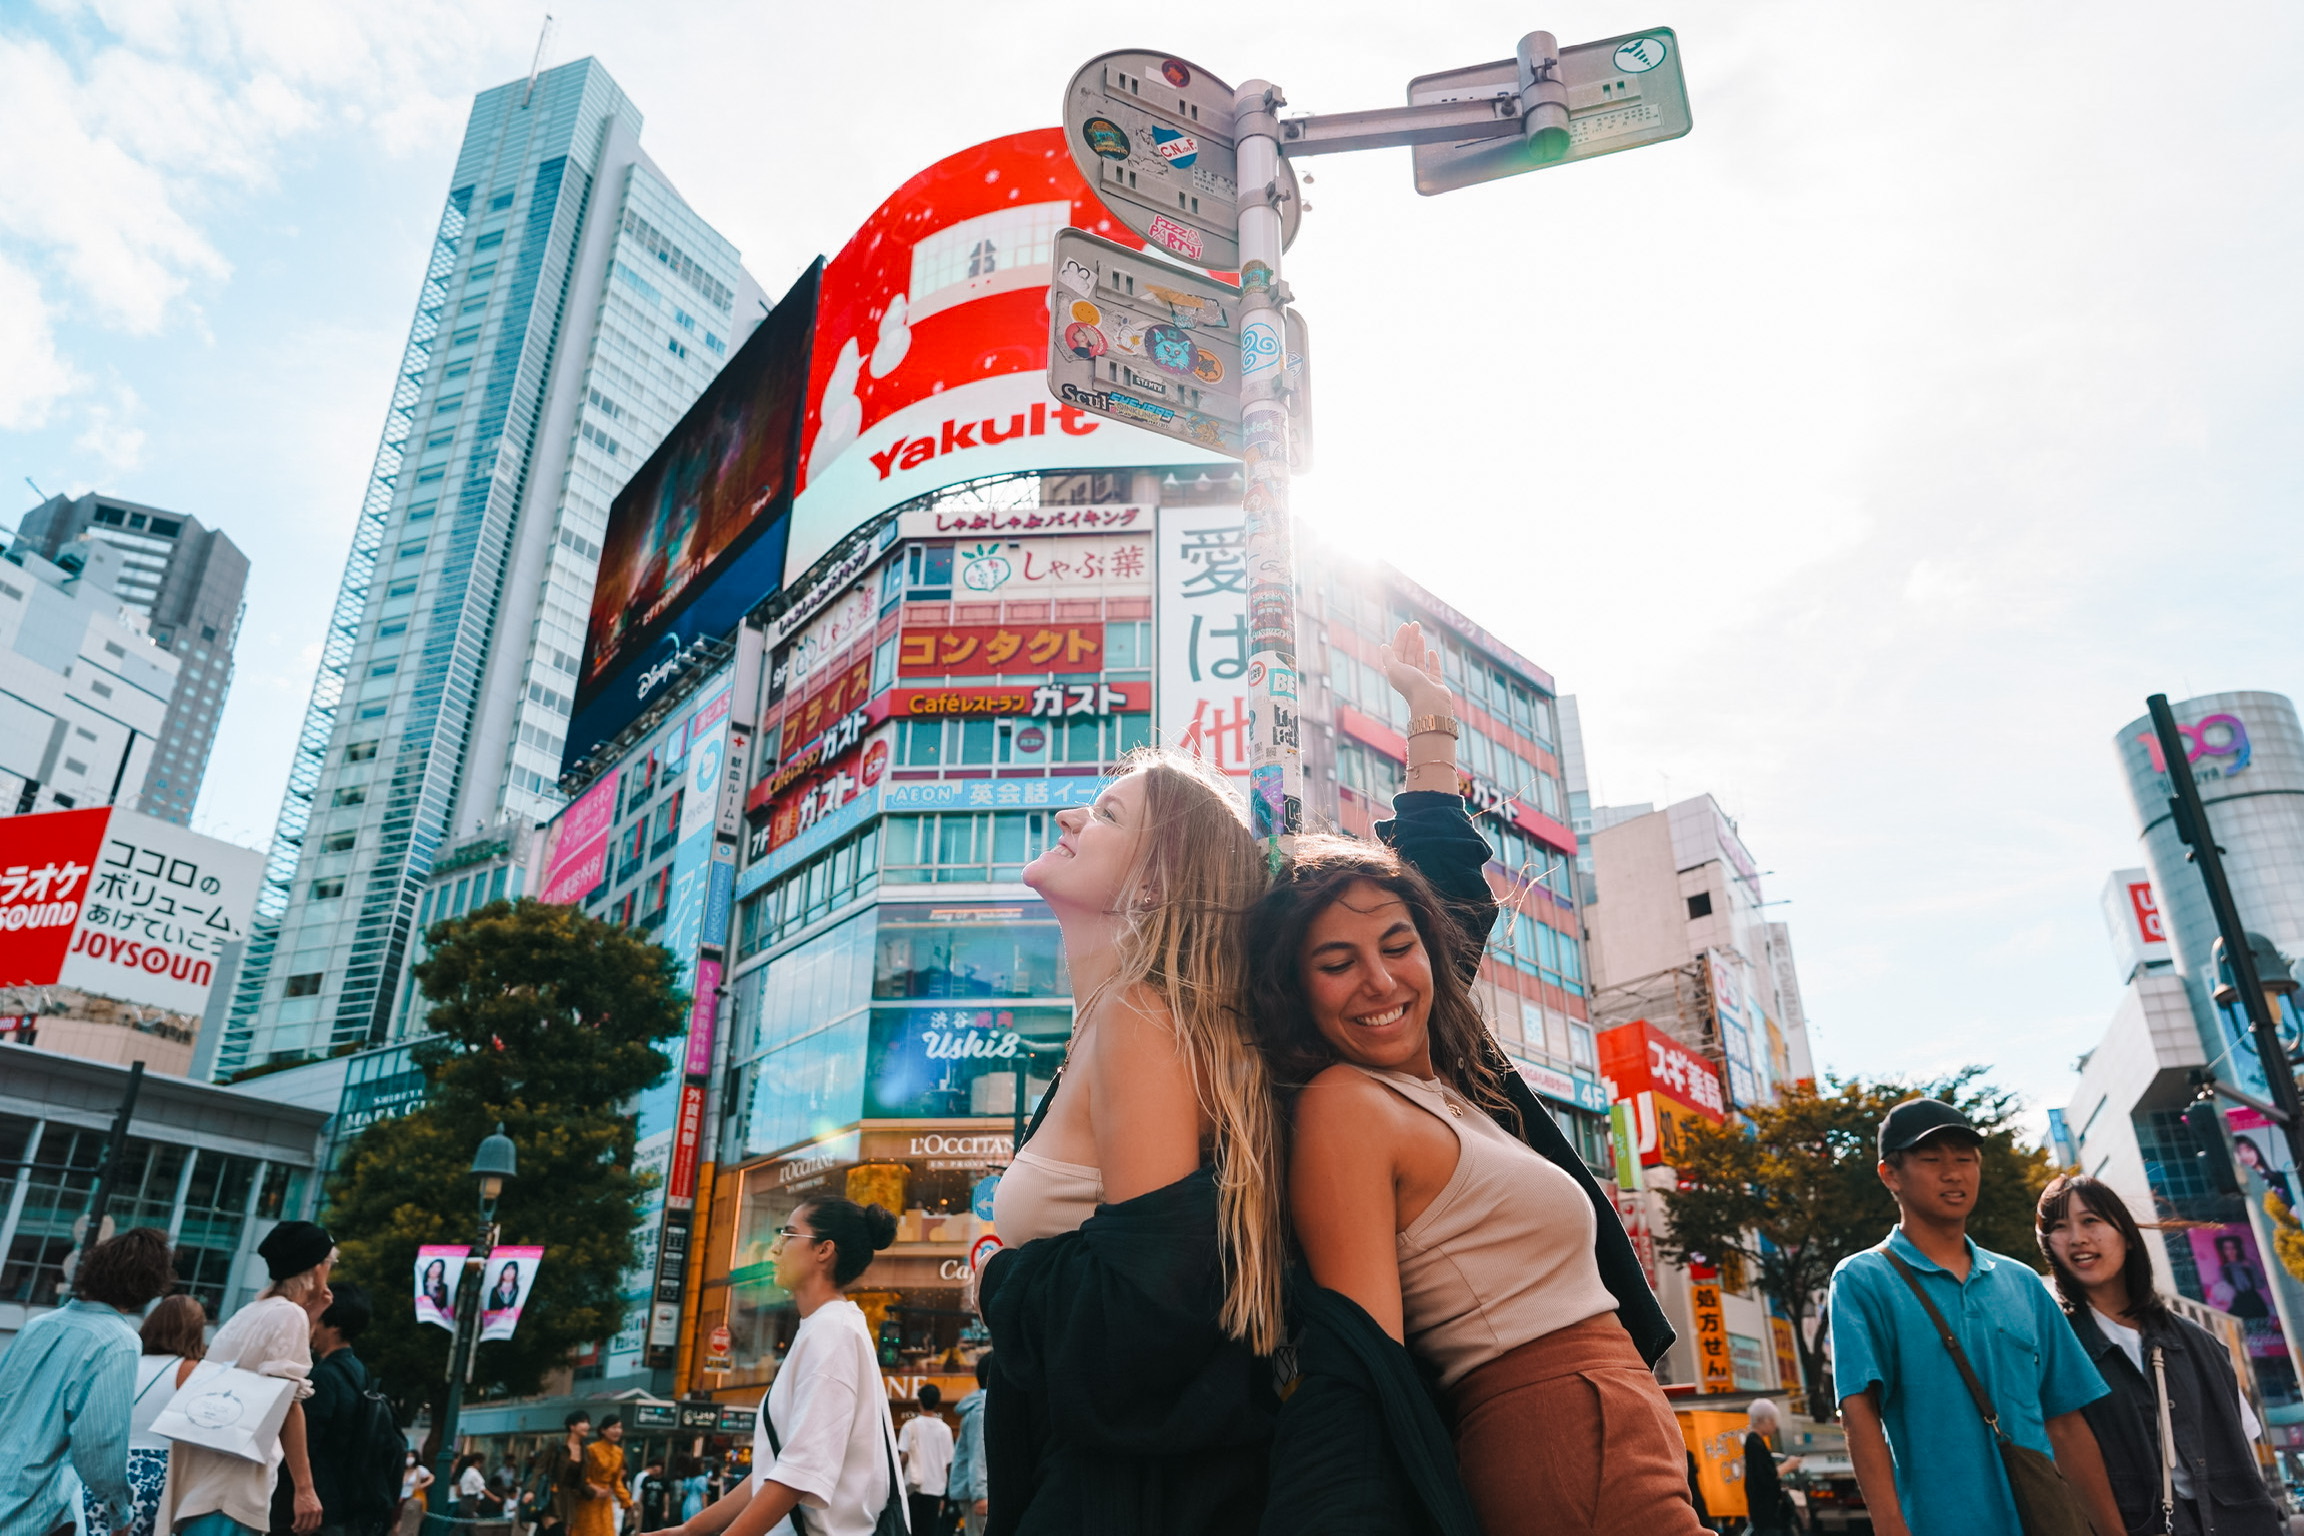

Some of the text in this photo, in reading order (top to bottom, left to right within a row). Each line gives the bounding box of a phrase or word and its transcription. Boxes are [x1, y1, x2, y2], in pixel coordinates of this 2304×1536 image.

[868, 402, 1100, 481] Yakult
[936, 507, 1140, 531] しゃぶしゃぶバイキング
[1023, 545, 1146, 580] しゃぶ葉
[901, 629, 1099, 666] コンタクト
[1031, 683, 1127, 717] ガスト
[798, 769, 855, 835] ガスト
[894, 785, 951, 802] AEON
[752, 825, 770, 857] 7F
[0, 860, 89, 904] ラオケ
[105, 839, 220, 895] ココロの
[72, 929, 214, 987] JOYSOUN
[921, 1029, 1022, 1060] Ushi8
[1581, 1083, 1605, 1111] 4F
[910, 1134, 1015, 1155] L'OCCITAN
[1696, 1289, 1726, 1377] 処方せん
